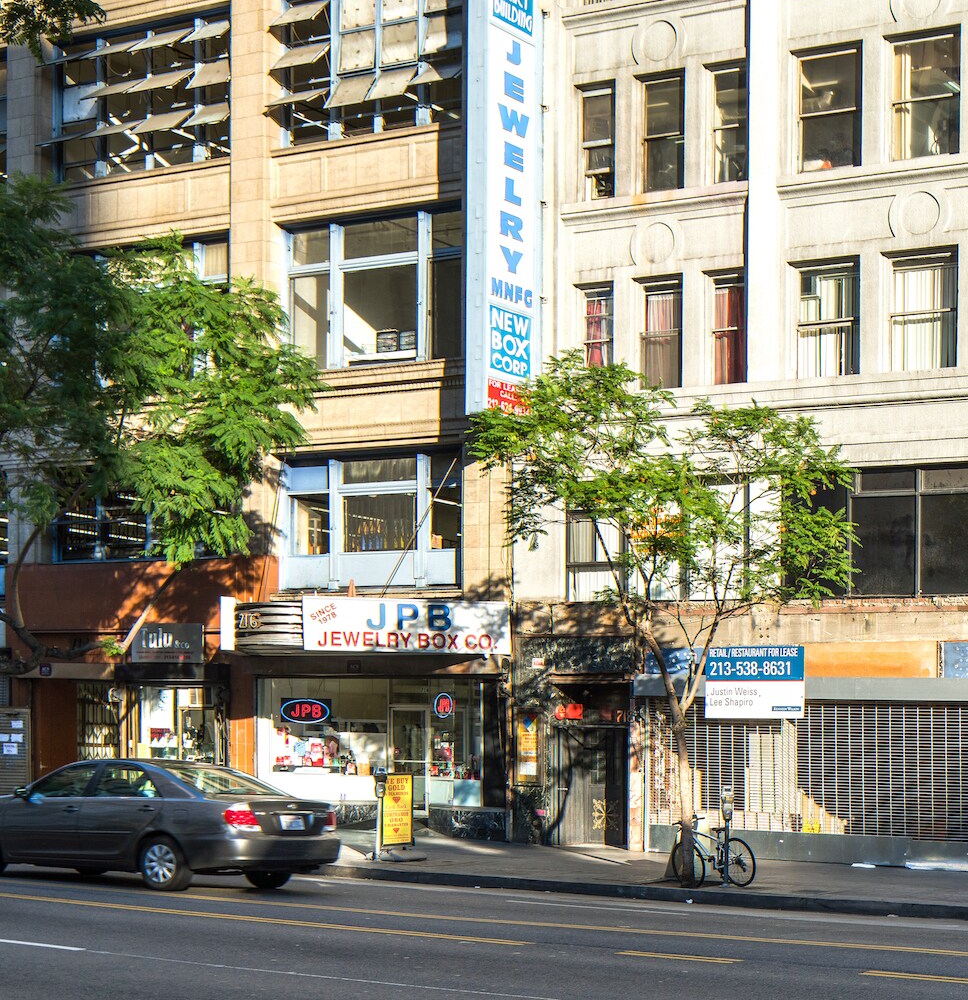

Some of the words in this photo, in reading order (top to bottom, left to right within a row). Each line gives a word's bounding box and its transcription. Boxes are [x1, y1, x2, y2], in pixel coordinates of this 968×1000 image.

[497, 39, 530, 275] JEWELRY
[491, 277, 533, 309] MNFG
[491, 307, 530, 339] NEW
[491, 329, 530, 361] BOX
[488, 379, 501, 390] FOR
[310, 602, 337, 621] SINCE
[318, 611, 337, 625] 1978
[140, 627, 173, 649] Tulu
[317, 631, 411, 648] JEWELRY
[417, 632, 458, 650] BOX
[464, 633, 498, 650] CO.
[709, 648, 727, 658] RETAIL
[731, 648, 768, 657] RESTAURANT
[768, 648, 780, 657] FOR
[780, 647, 798, 657] LEASE
[710, 661, 791, 676] 213-538-8631
[711, 687, 733, 696] Justin
[734, 687, 758, 696] Weiss
[709, 698, 723, 706] Lee
[724, 697, 754, 707] Shapiro
[291, 703, 323, 718] JPB
[396, 777, 409, 785] BUY
